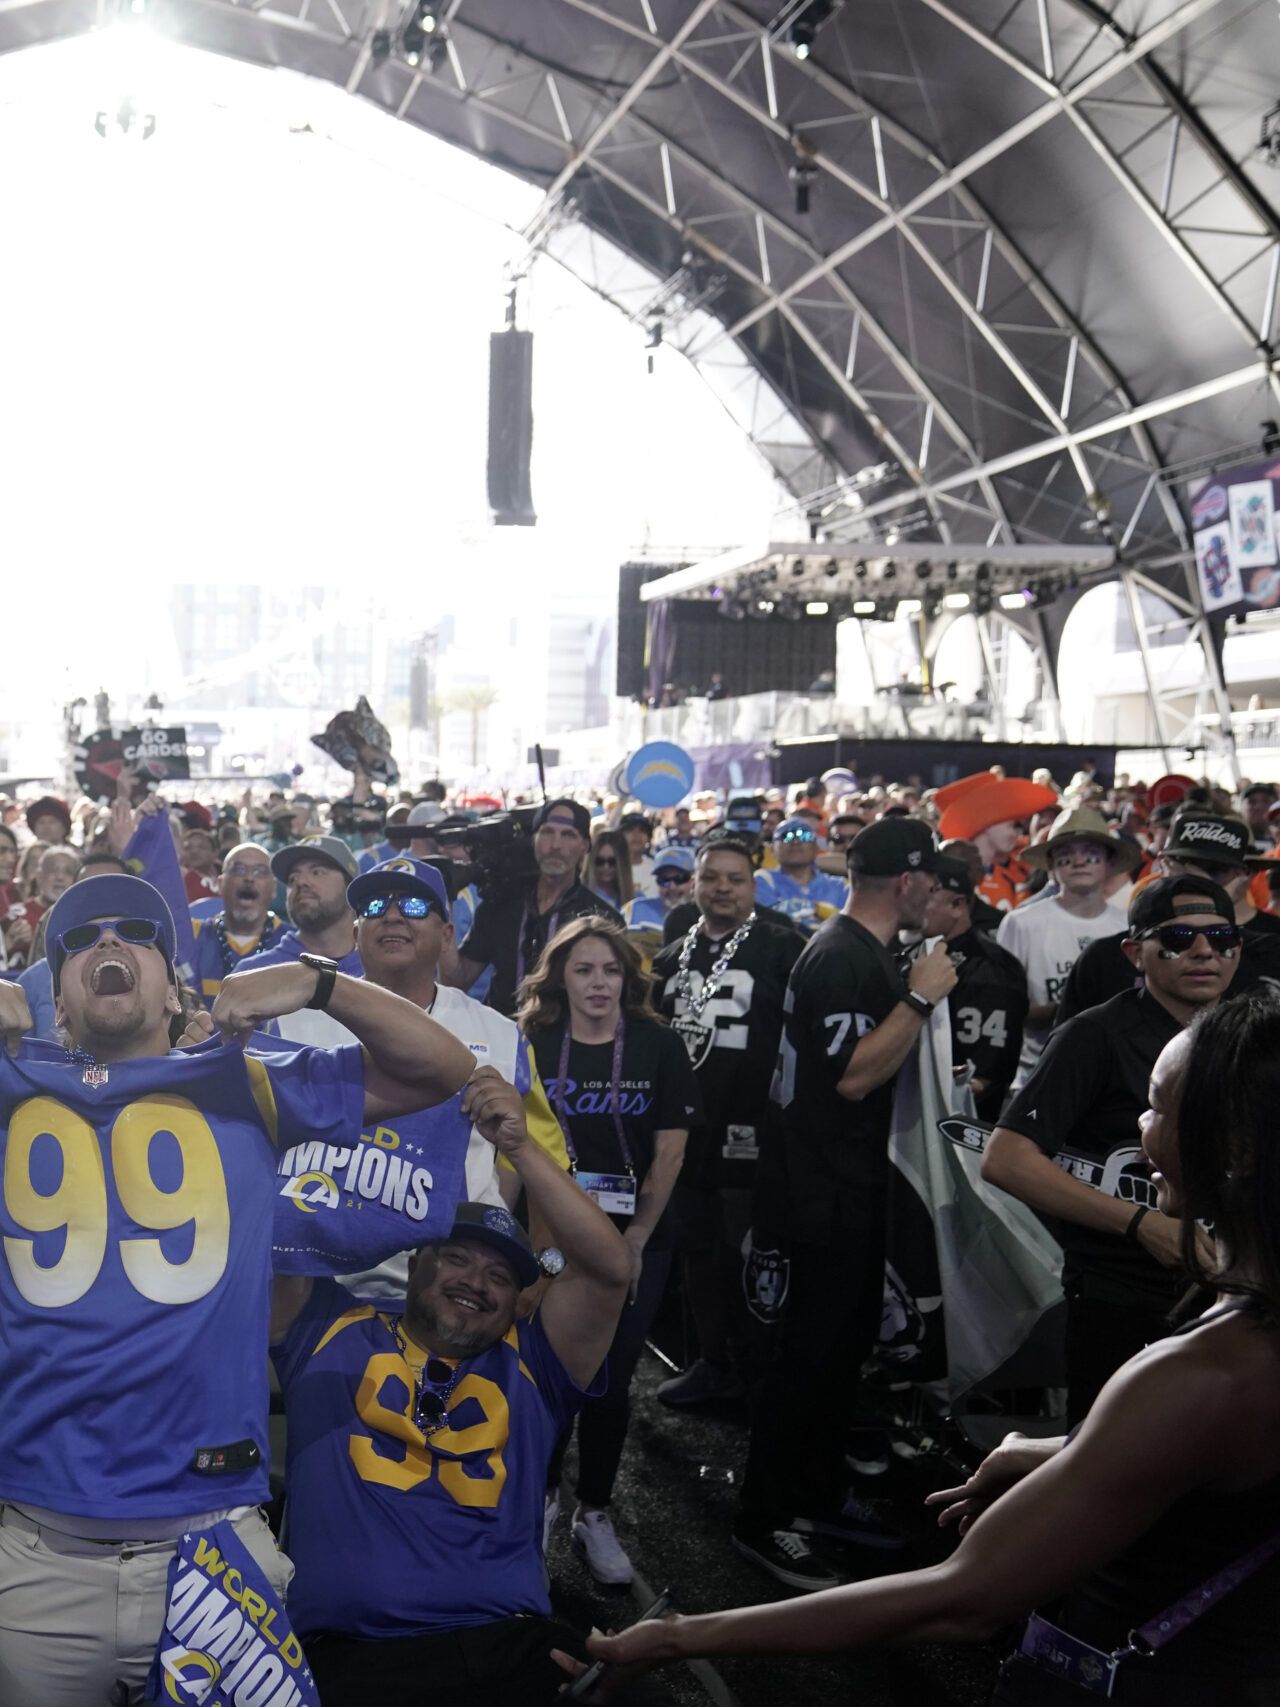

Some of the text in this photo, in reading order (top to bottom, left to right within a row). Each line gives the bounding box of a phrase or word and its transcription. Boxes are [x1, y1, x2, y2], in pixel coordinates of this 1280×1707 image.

[141, 730, 168, 744] GO
[1180, 821, 1241, 849] Raiders
[956, 1006, 1008, 1048] 34
[583, 1080, 651, 1089] LOS AGELES
[3, 1092, 232, 1308] 99
[277, 1141, 434, 1221] MPIONS
[349, 1352, 510, 1508] 99
[193, 1537, 303, 1669] WORLD
